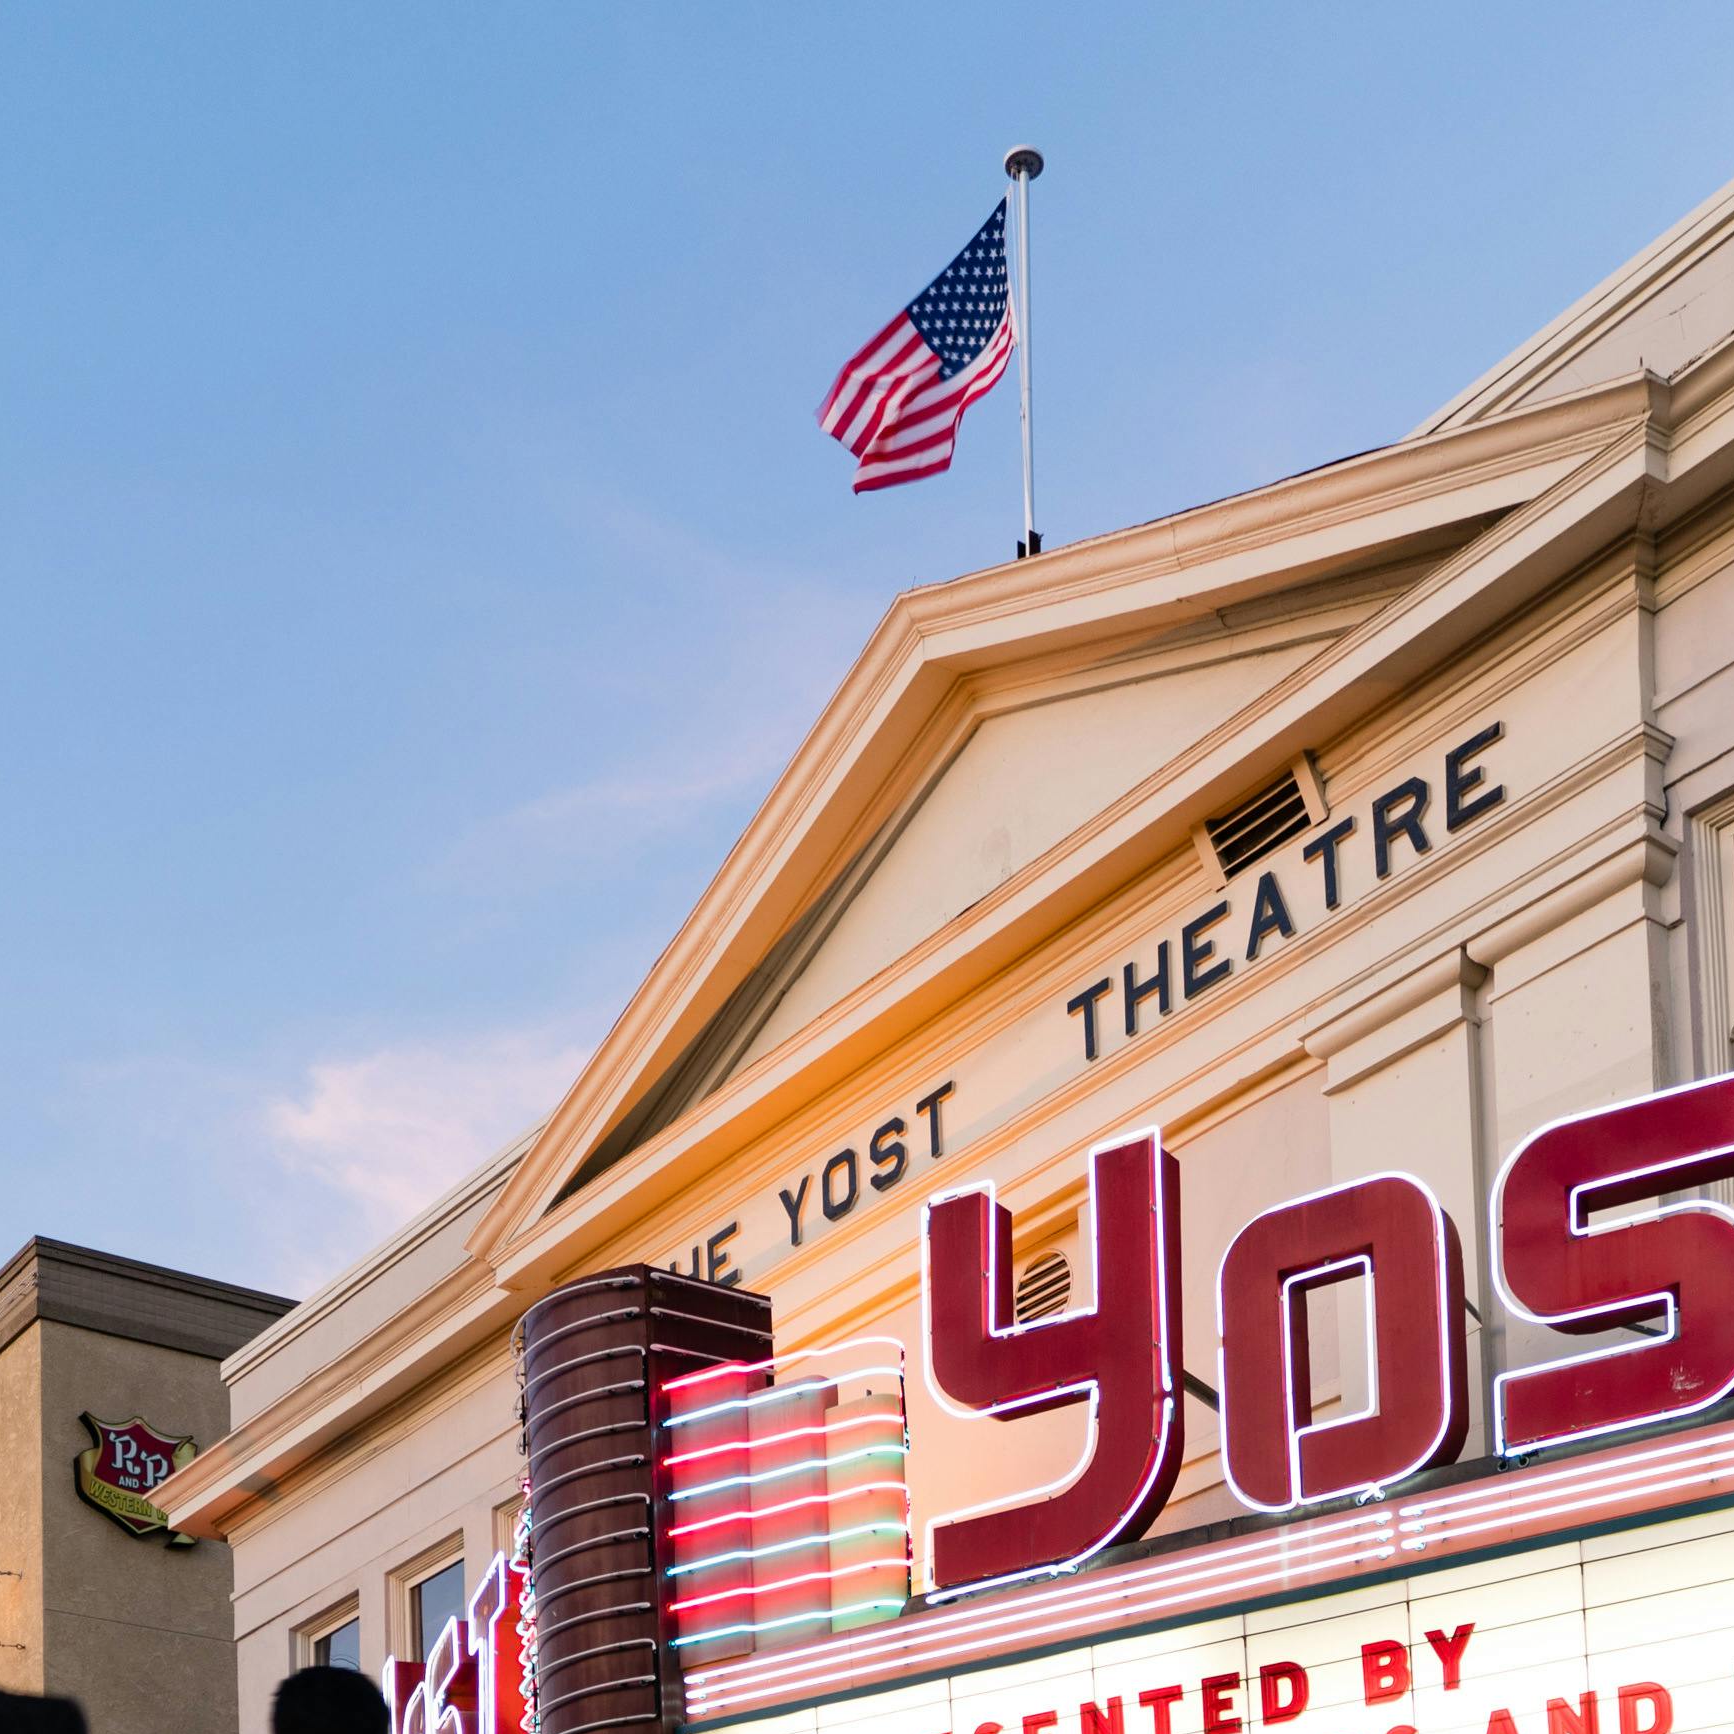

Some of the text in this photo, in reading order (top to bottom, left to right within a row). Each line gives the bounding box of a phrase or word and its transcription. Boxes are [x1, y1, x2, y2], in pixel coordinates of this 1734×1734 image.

[778, 721, 1506, 1247] YOST THEATRE
[88, 1479, 154, 1518] WESTERN
[119, 1475, 139, 1489] AND
[1360, 1623, 1475, 1706] BY
